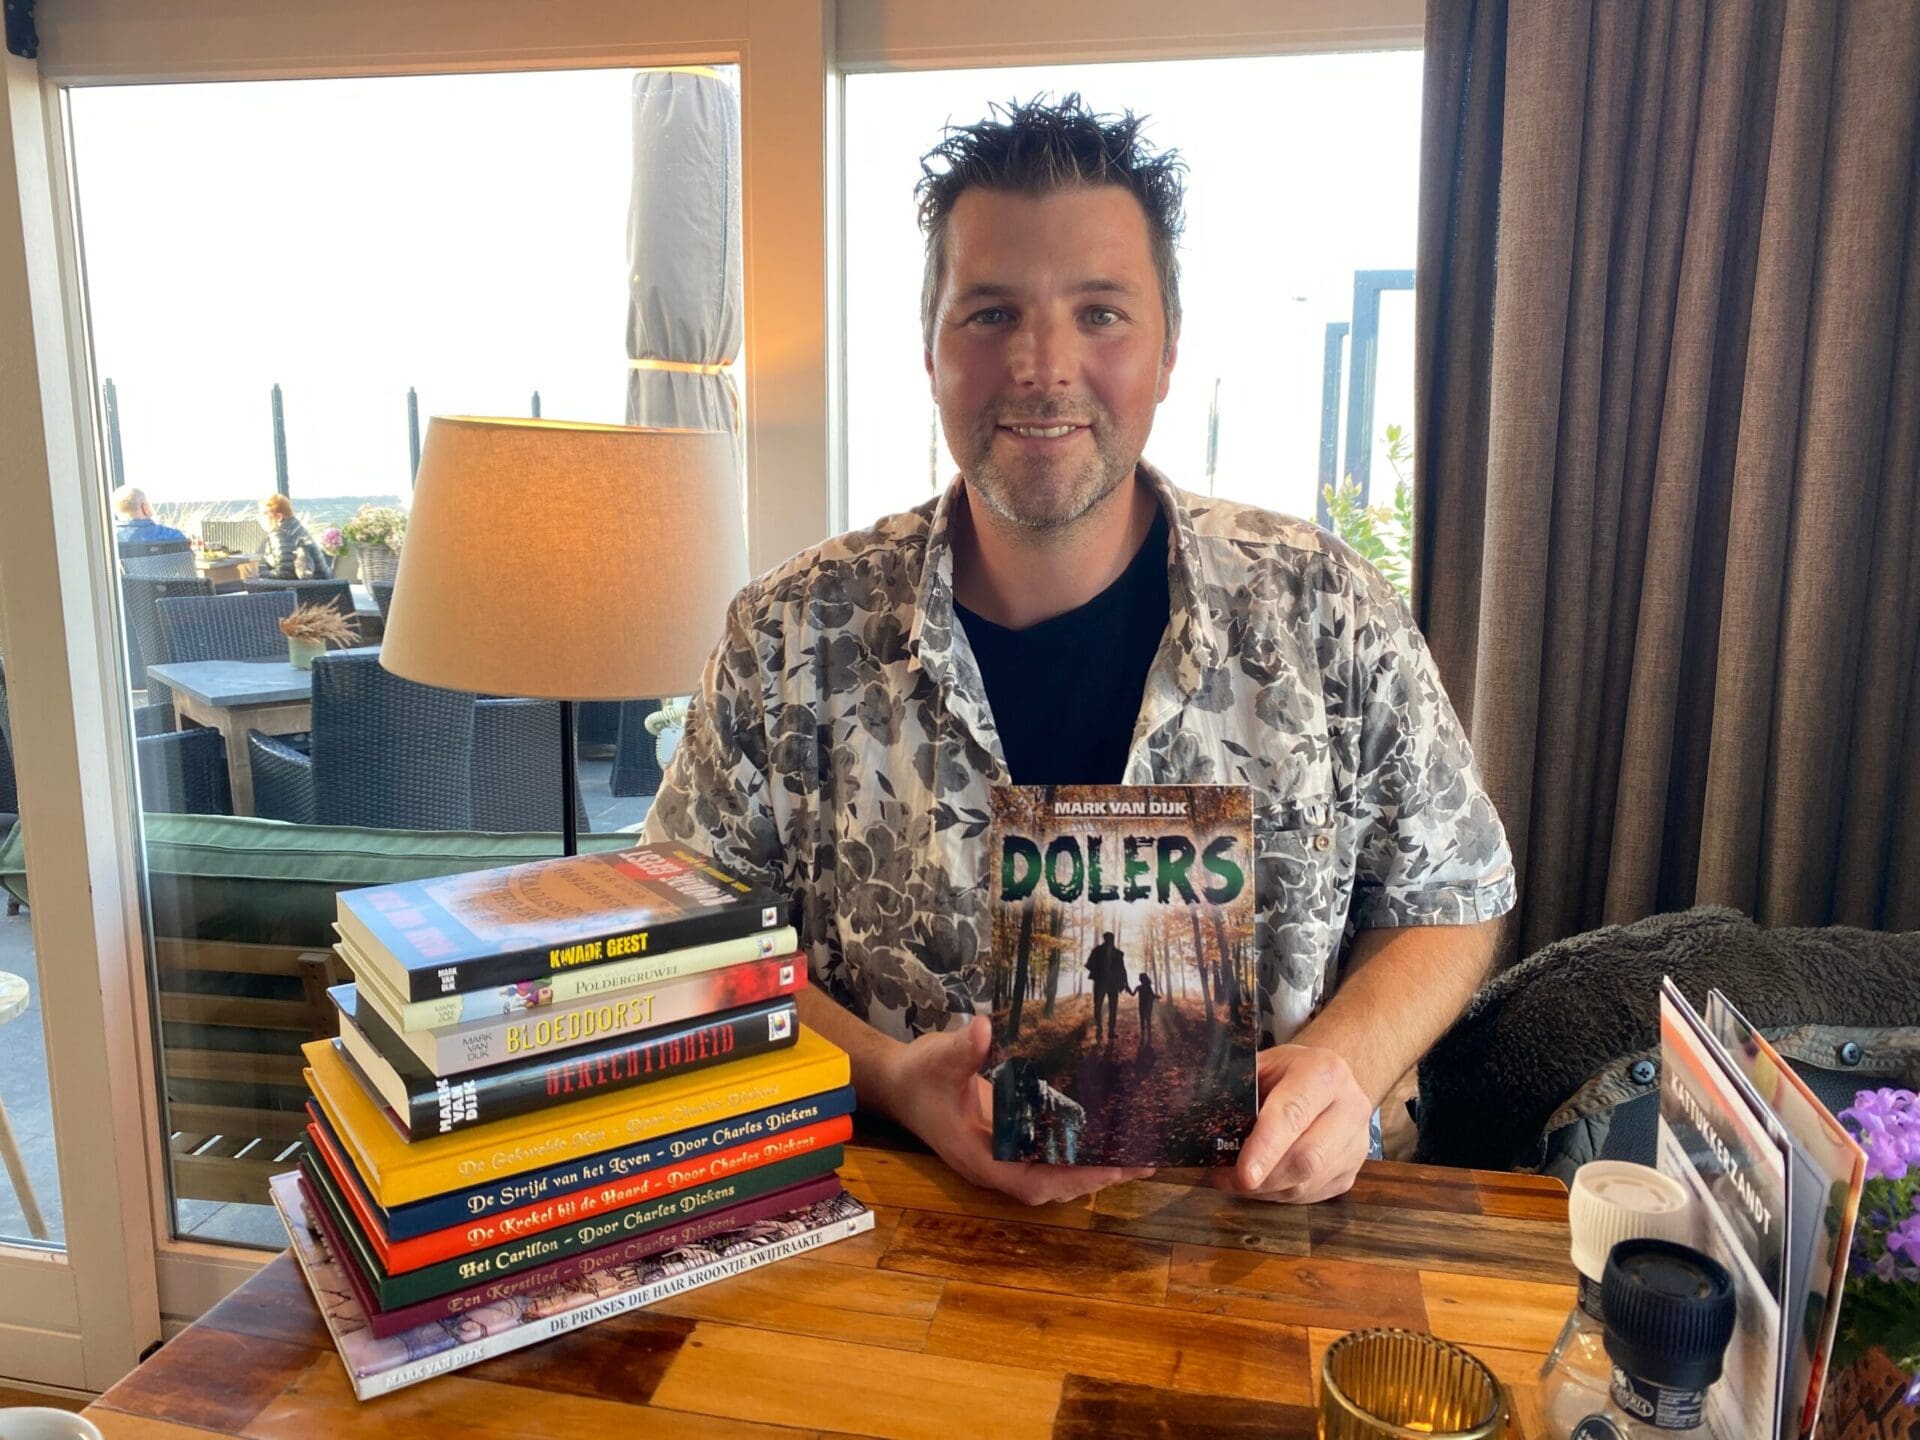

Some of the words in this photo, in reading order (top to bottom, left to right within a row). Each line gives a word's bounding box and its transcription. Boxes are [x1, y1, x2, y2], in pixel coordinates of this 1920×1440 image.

[1054, 801, 1107, 815] MARK
[1110, 801, 1146, 815] VAN
[1149, 801, 1189, 815] DIJK
[1001, 834, 1245, 905] DOLERS
[437, 967, 457, 977] MARK
[549, 941, 603, 969] KWADE
[606, 933, 649, 959] GEEST
[441, 975, 455, 984] VAN
[463, 1032, 493, 1046] MARK
[507, 994, 655, 1054] BLOEDDORST
[467, 1042, 488, 1052] VAN
[467, 1052, 489, 1061] DIJK
[436, 1078, 452, 1133] MARK
[451, 1085, 465, 1123] VAN
[463, 1079, 478, 1121] DIJK
[467, 1195, 494, 1214] De
[500, 1177, 548, 1206] Strijd
[552, 1172, 578, 1187] van
[582, 1163, 604, 1180] het
[608, 1153, 650, 1174] Leven
[669, 1135, 708, 1158] Door
[712, 1120, 762, 1146] Charles
[765, 1104, 819, 1131] Dickens
[1216, 1138, 1240, 1151] Deel
[467, 1228, 494, 1246] De
[499, 1207, 553, 1236] Krekel
[580, 1196, 596, 1211] de
[600, 1180, 649, 1205] Haard
[667, 1166, 705, 1188] Door
[710, 1150, 760, 1175] Charles
[763, 1135, 816, 1161] Dickens
[459, 1258, 490, 1280] Het
[495, 1239, 559, 1270] Carillon
[578, 1221, 619, 1245] Door
[623, 1204, 676, 1230] Charles
[680, 1185, 735, 1213] Dickens
[447, 1294, 481, 1313] Een
[486, 1270, 558, 1297] Kerstlied
[579, 1251, 619, 1273] Door
[624, 1232, 677, 1259] Charles
[682, 1216, 736, 1241] Dickens
[550, 1318, 568, 1333] DE
[571, 1297, 625, 1326] PRINSES
[629, 1289, 650, 1306] DIE
[653, 1277, 685, 1298] HAAR
[688, 1256, 747, 1288] KROONTJE
[750, 1231, 823, 1266] KWIJTRAAKTE
[385, 1369, 423, 1389] MARK
[425, 1357, 451, 1375] VAN
[455, 1346, 485, 1367] DIJK
